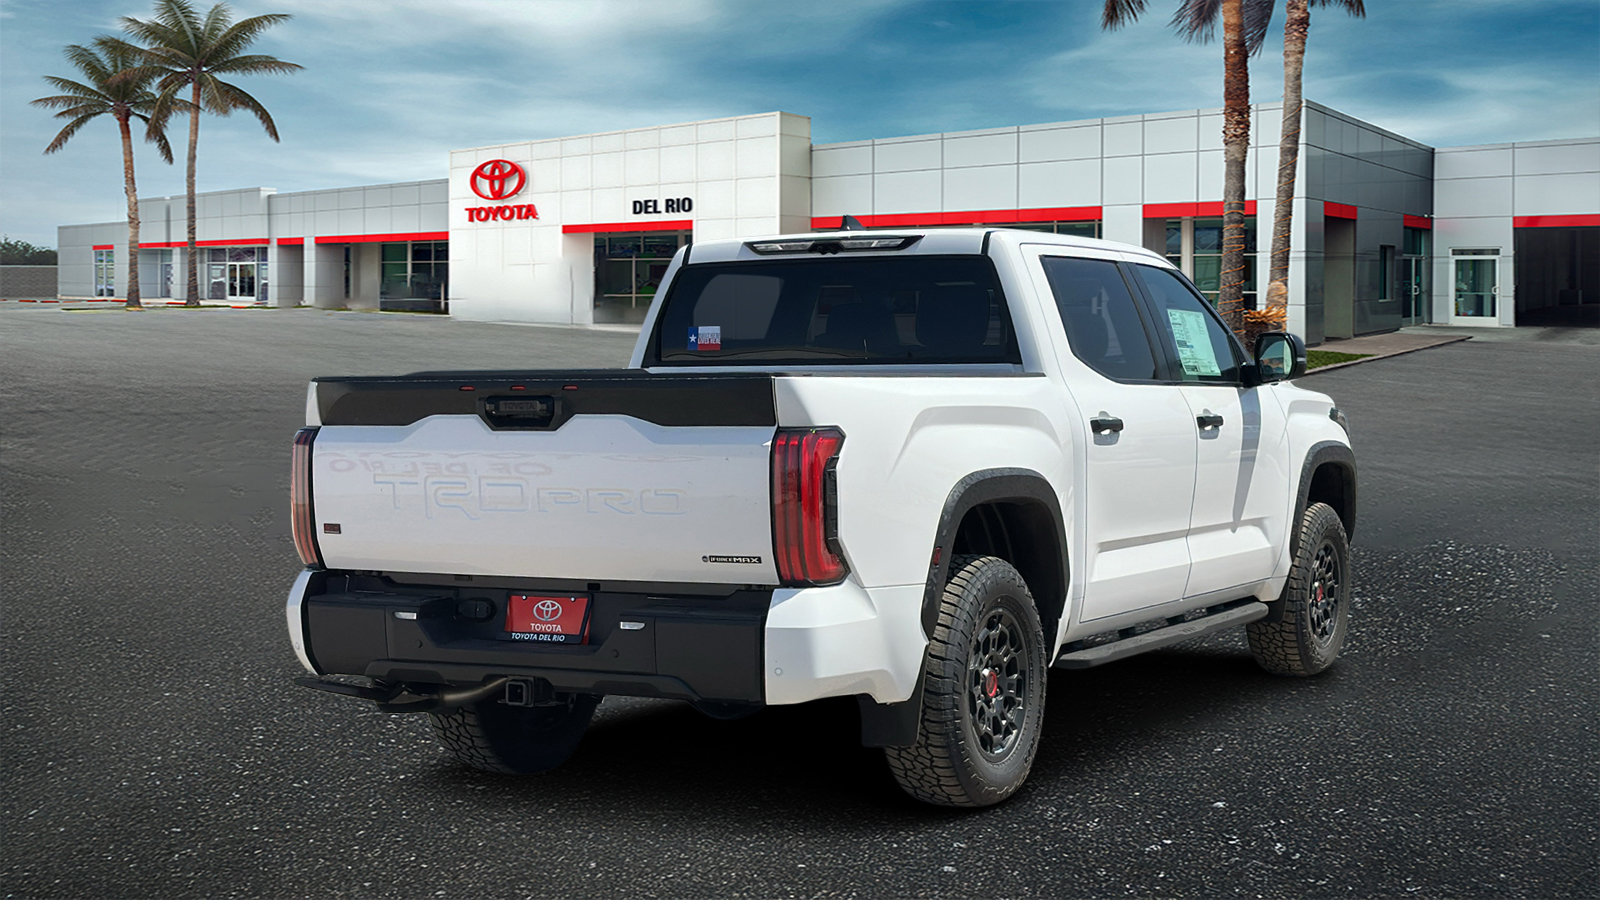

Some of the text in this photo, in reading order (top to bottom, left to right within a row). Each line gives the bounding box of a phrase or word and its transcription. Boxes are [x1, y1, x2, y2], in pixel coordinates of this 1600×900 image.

[632, 197, 693, 215] DEL RIO
[465, 204, 539, 222] TOYOTA
[503, 401, 536, 410] TOYOTA
[373, 473, 688, 521] TRD PRO
[530, 623, 562, 632] TOYOTA
[511, 632, 537, 641] TOYOTA
